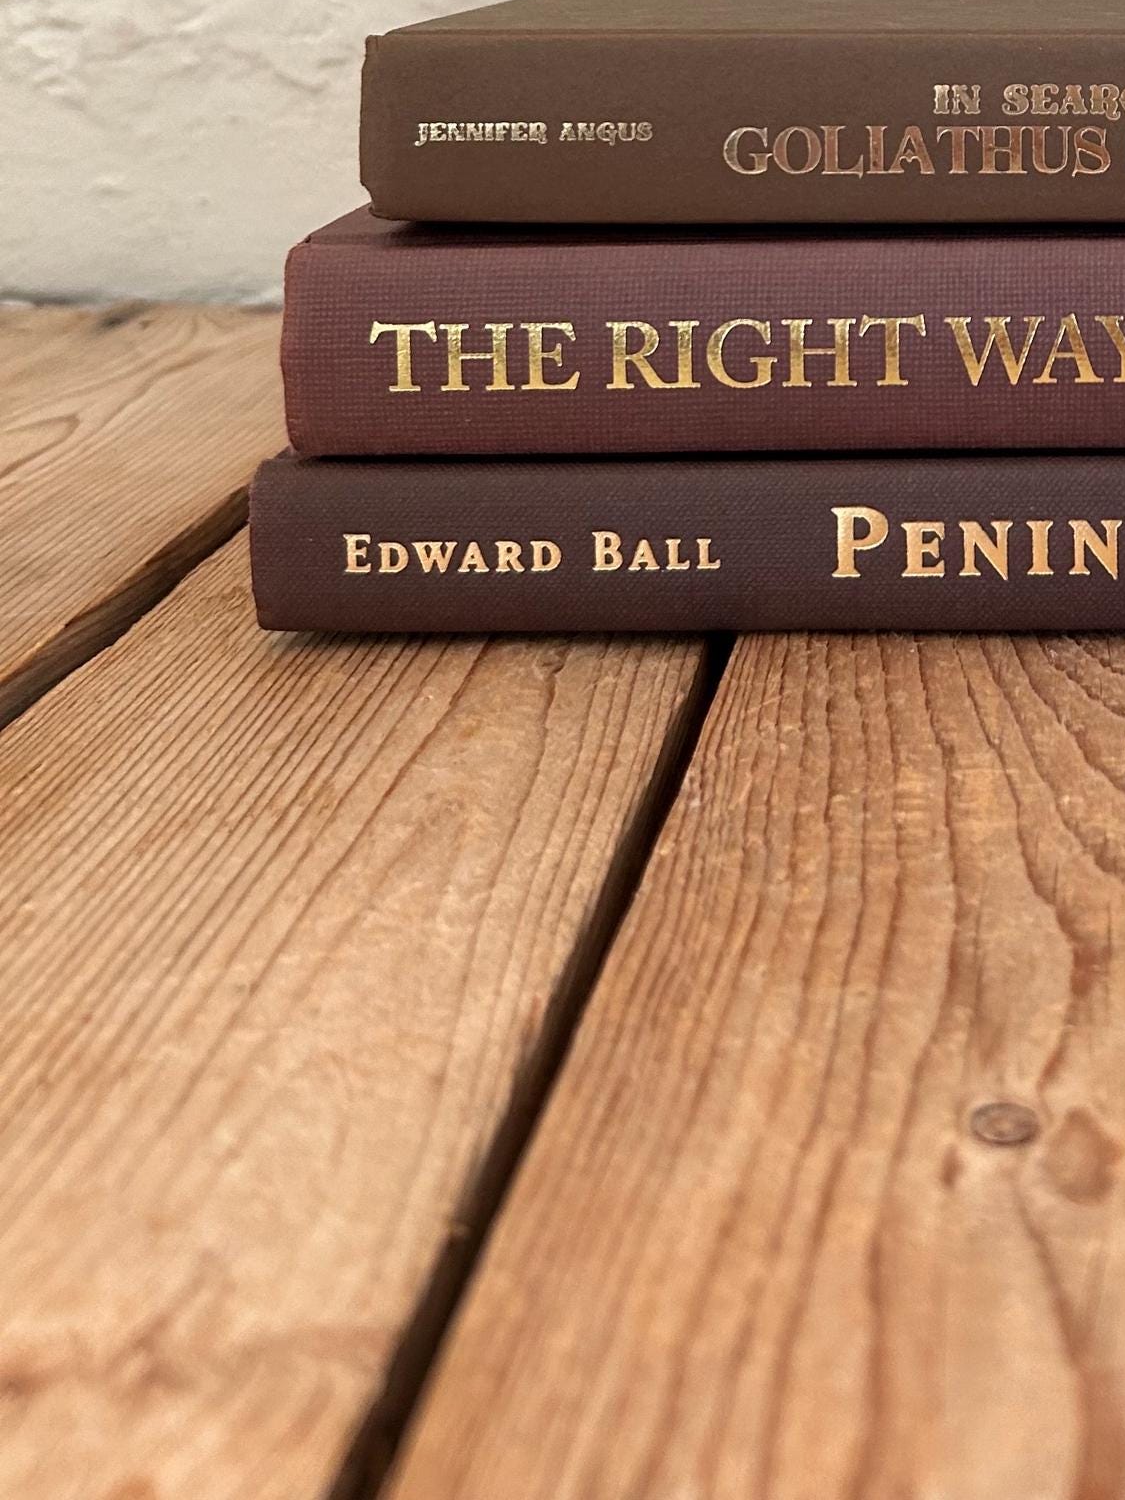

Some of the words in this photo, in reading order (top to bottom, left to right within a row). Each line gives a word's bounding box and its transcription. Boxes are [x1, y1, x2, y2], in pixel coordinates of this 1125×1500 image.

[933, 84, 982, 115] IN
[414, 121, 548, 148] JENNIFER
[559, 122, 654, 147] ANGUS
[722, 124, 1112, 179] GOLIATHUS
[369, 320, 581, 393] THE
[606, 313, 927, 391] RIGHT
